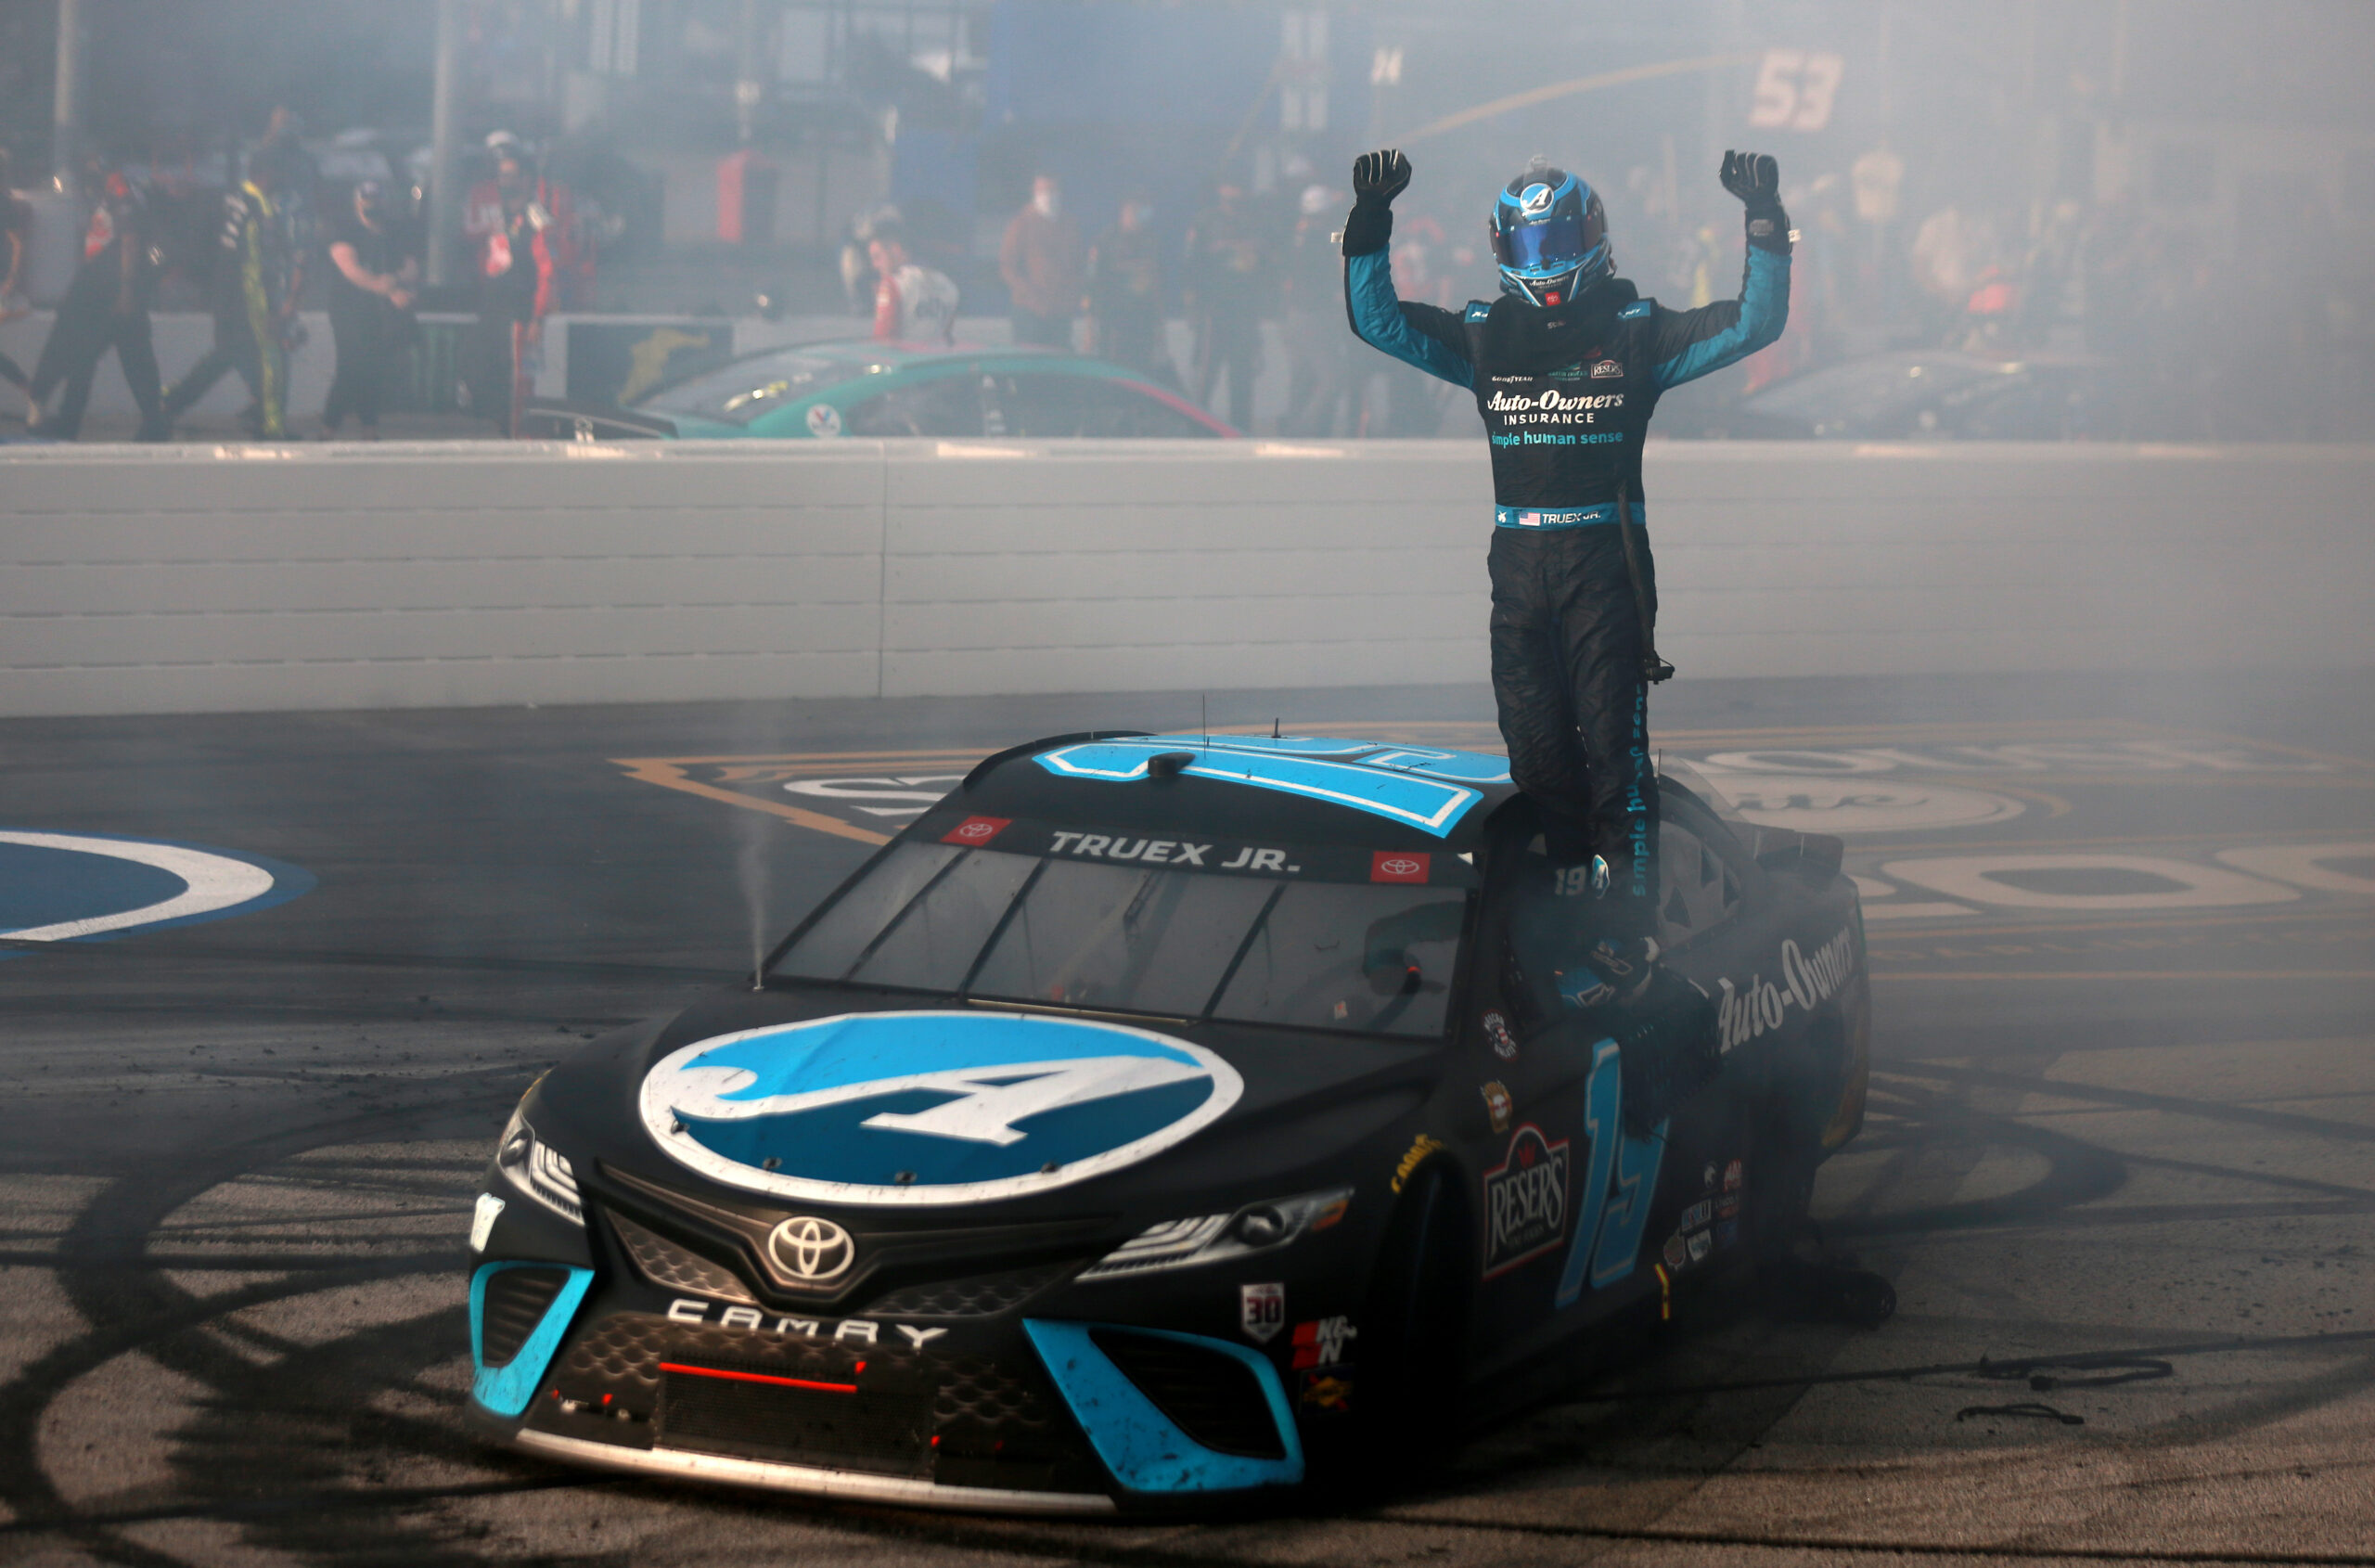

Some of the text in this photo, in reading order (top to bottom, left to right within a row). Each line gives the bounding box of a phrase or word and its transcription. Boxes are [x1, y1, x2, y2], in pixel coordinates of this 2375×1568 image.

[1748, 47, 1844, 132] 53
[1492, 376, 1533, 384] GOODYEAR
[1487, 390, 1624, 411] Auto-Owners
[1504, 413, 1595, 426] INSURANCE
[1492, 431, 1624, 449] simple human sense
[1542, 513, 1582, 524] TRUEX
[1050, 830, 1301, 873] TRUEX JR.
[1628, 817, 1650, 897] simple
[1554, 865, 1587, 897] 19
[666, 1297, 949, 1349] CAMRY
[1246, 1295, 1281, 1324] 30
